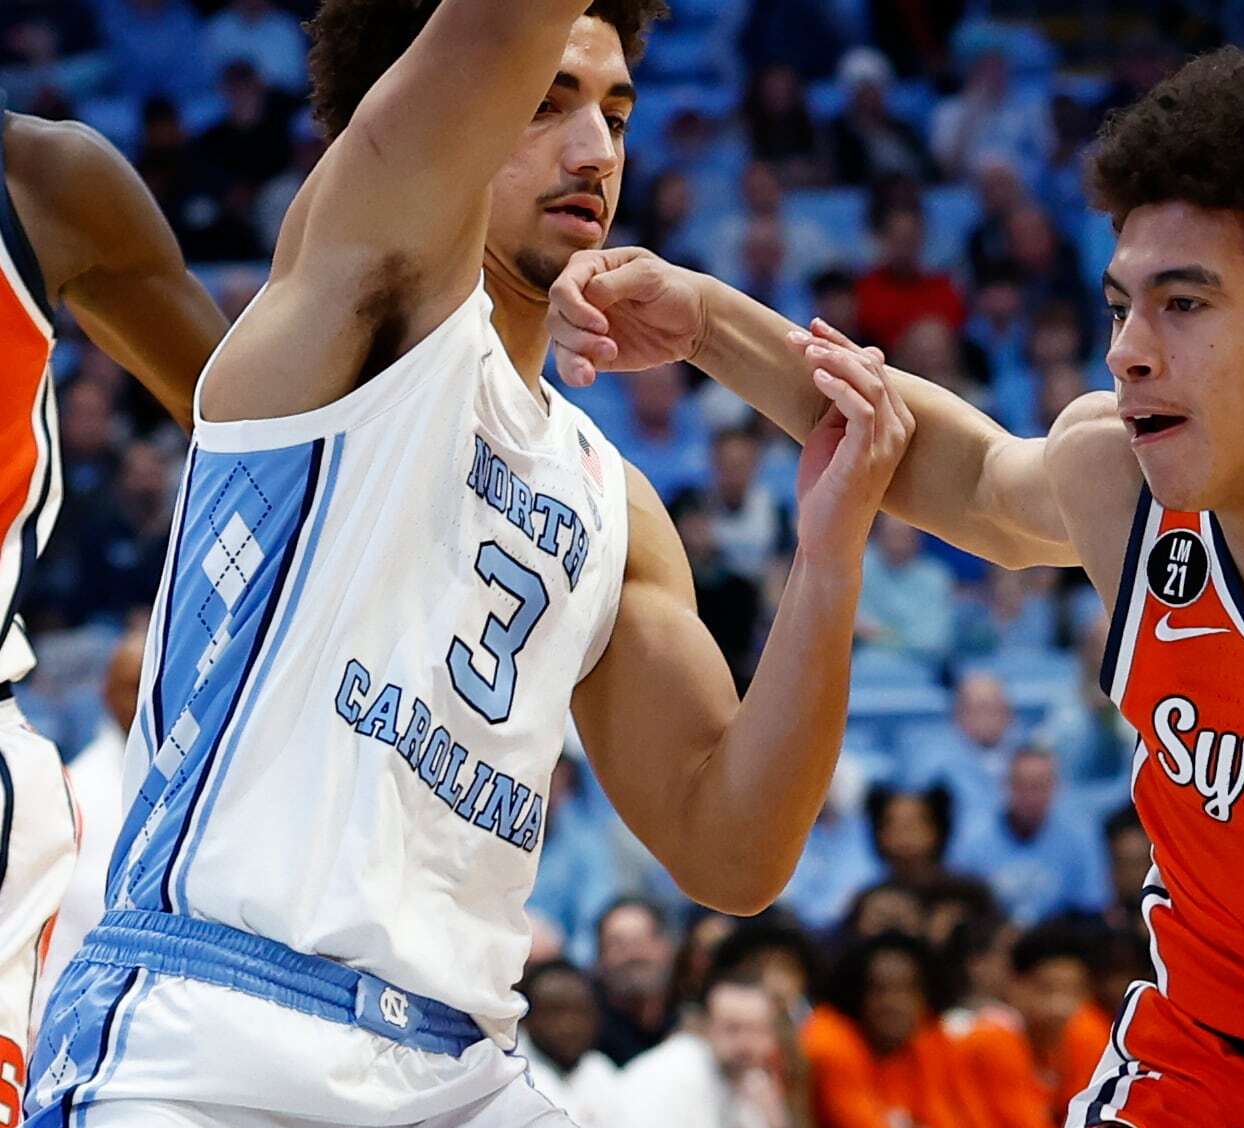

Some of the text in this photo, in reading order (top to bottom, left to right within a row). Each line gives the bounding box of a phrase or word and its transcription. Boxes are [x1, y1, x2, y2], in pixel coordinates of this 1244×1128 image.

[466, 434, 591, 592] NORTH
[1163, 563, 1187, 598] 21
[1169, 537, 1193, 563] LM
[446, 540, 550, 725] 3
[335, 658, 545, 852] CAROLINA
